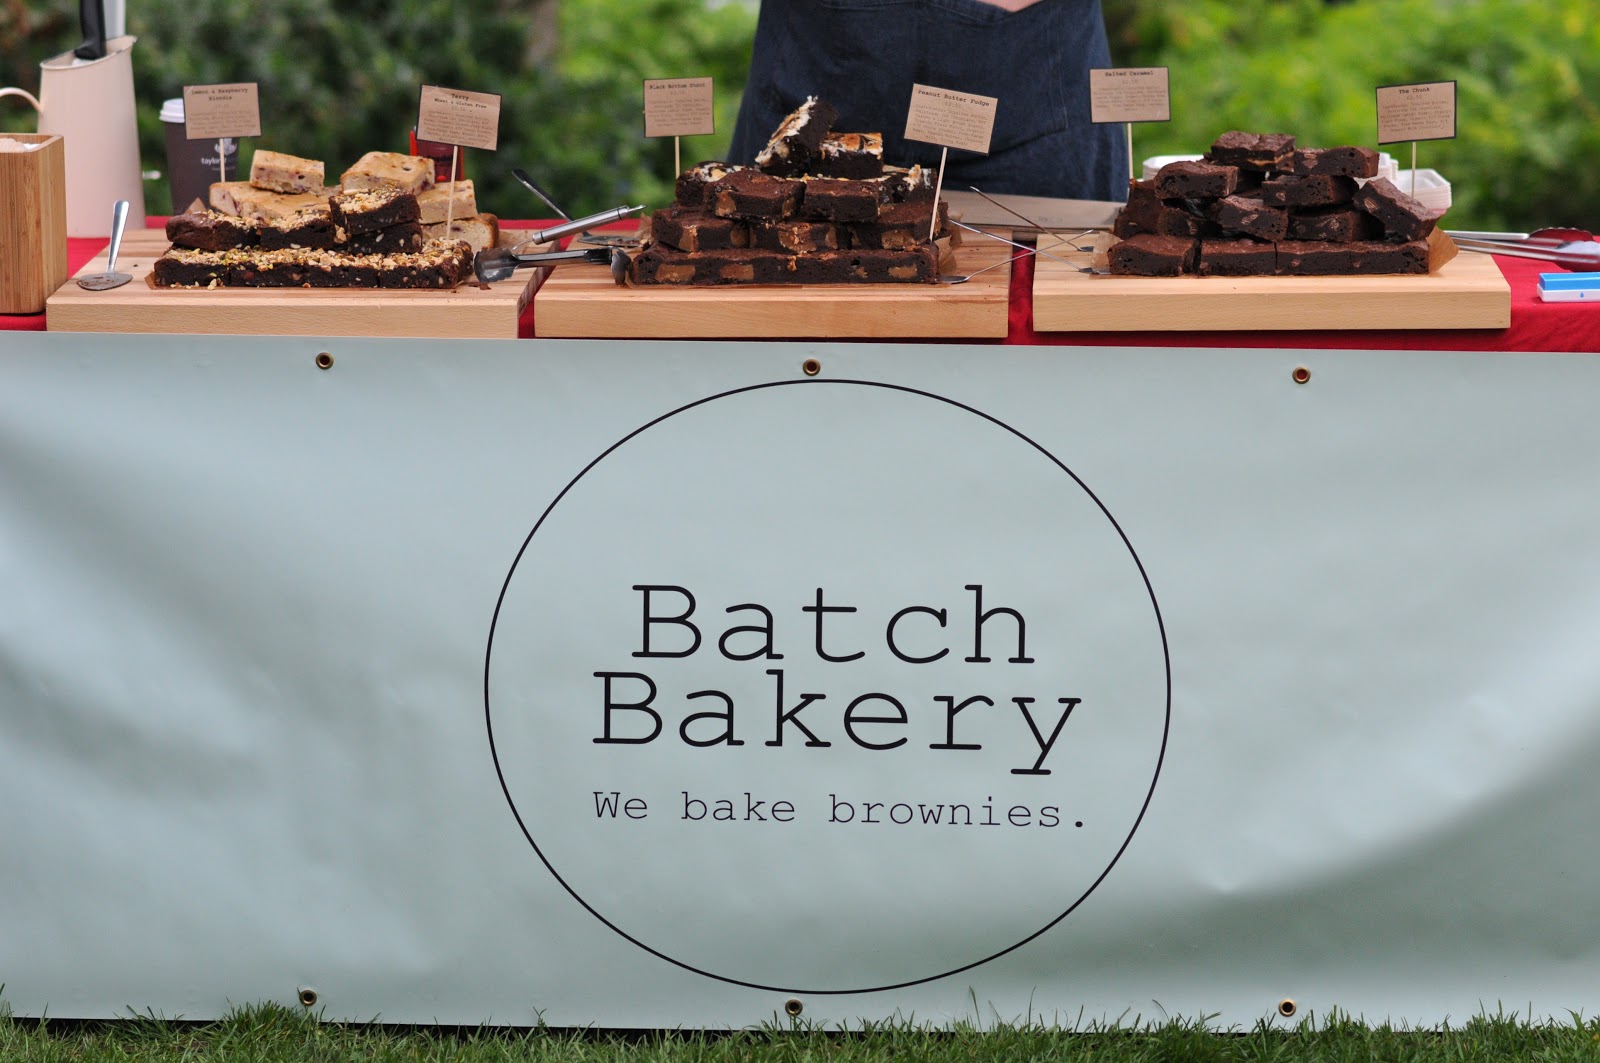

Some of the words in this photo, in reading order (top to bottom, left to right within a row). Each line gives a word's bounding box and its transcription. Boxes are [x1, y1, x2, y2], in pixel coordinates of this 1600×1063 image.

[451, 93, 470, 101] Terry
[917, 89, 941, 98] Peanut
[943, 93, 967, 103] Butter
[970, 98, 990, 107] Fudge
[631, 584, 1035, 664] Batch
[592, 669, 1082, 775] Bakery
[592, 791, 649, 820] We
[680, 791, 796, 822] bake
[828, 794, 1084, 828] brownies.
